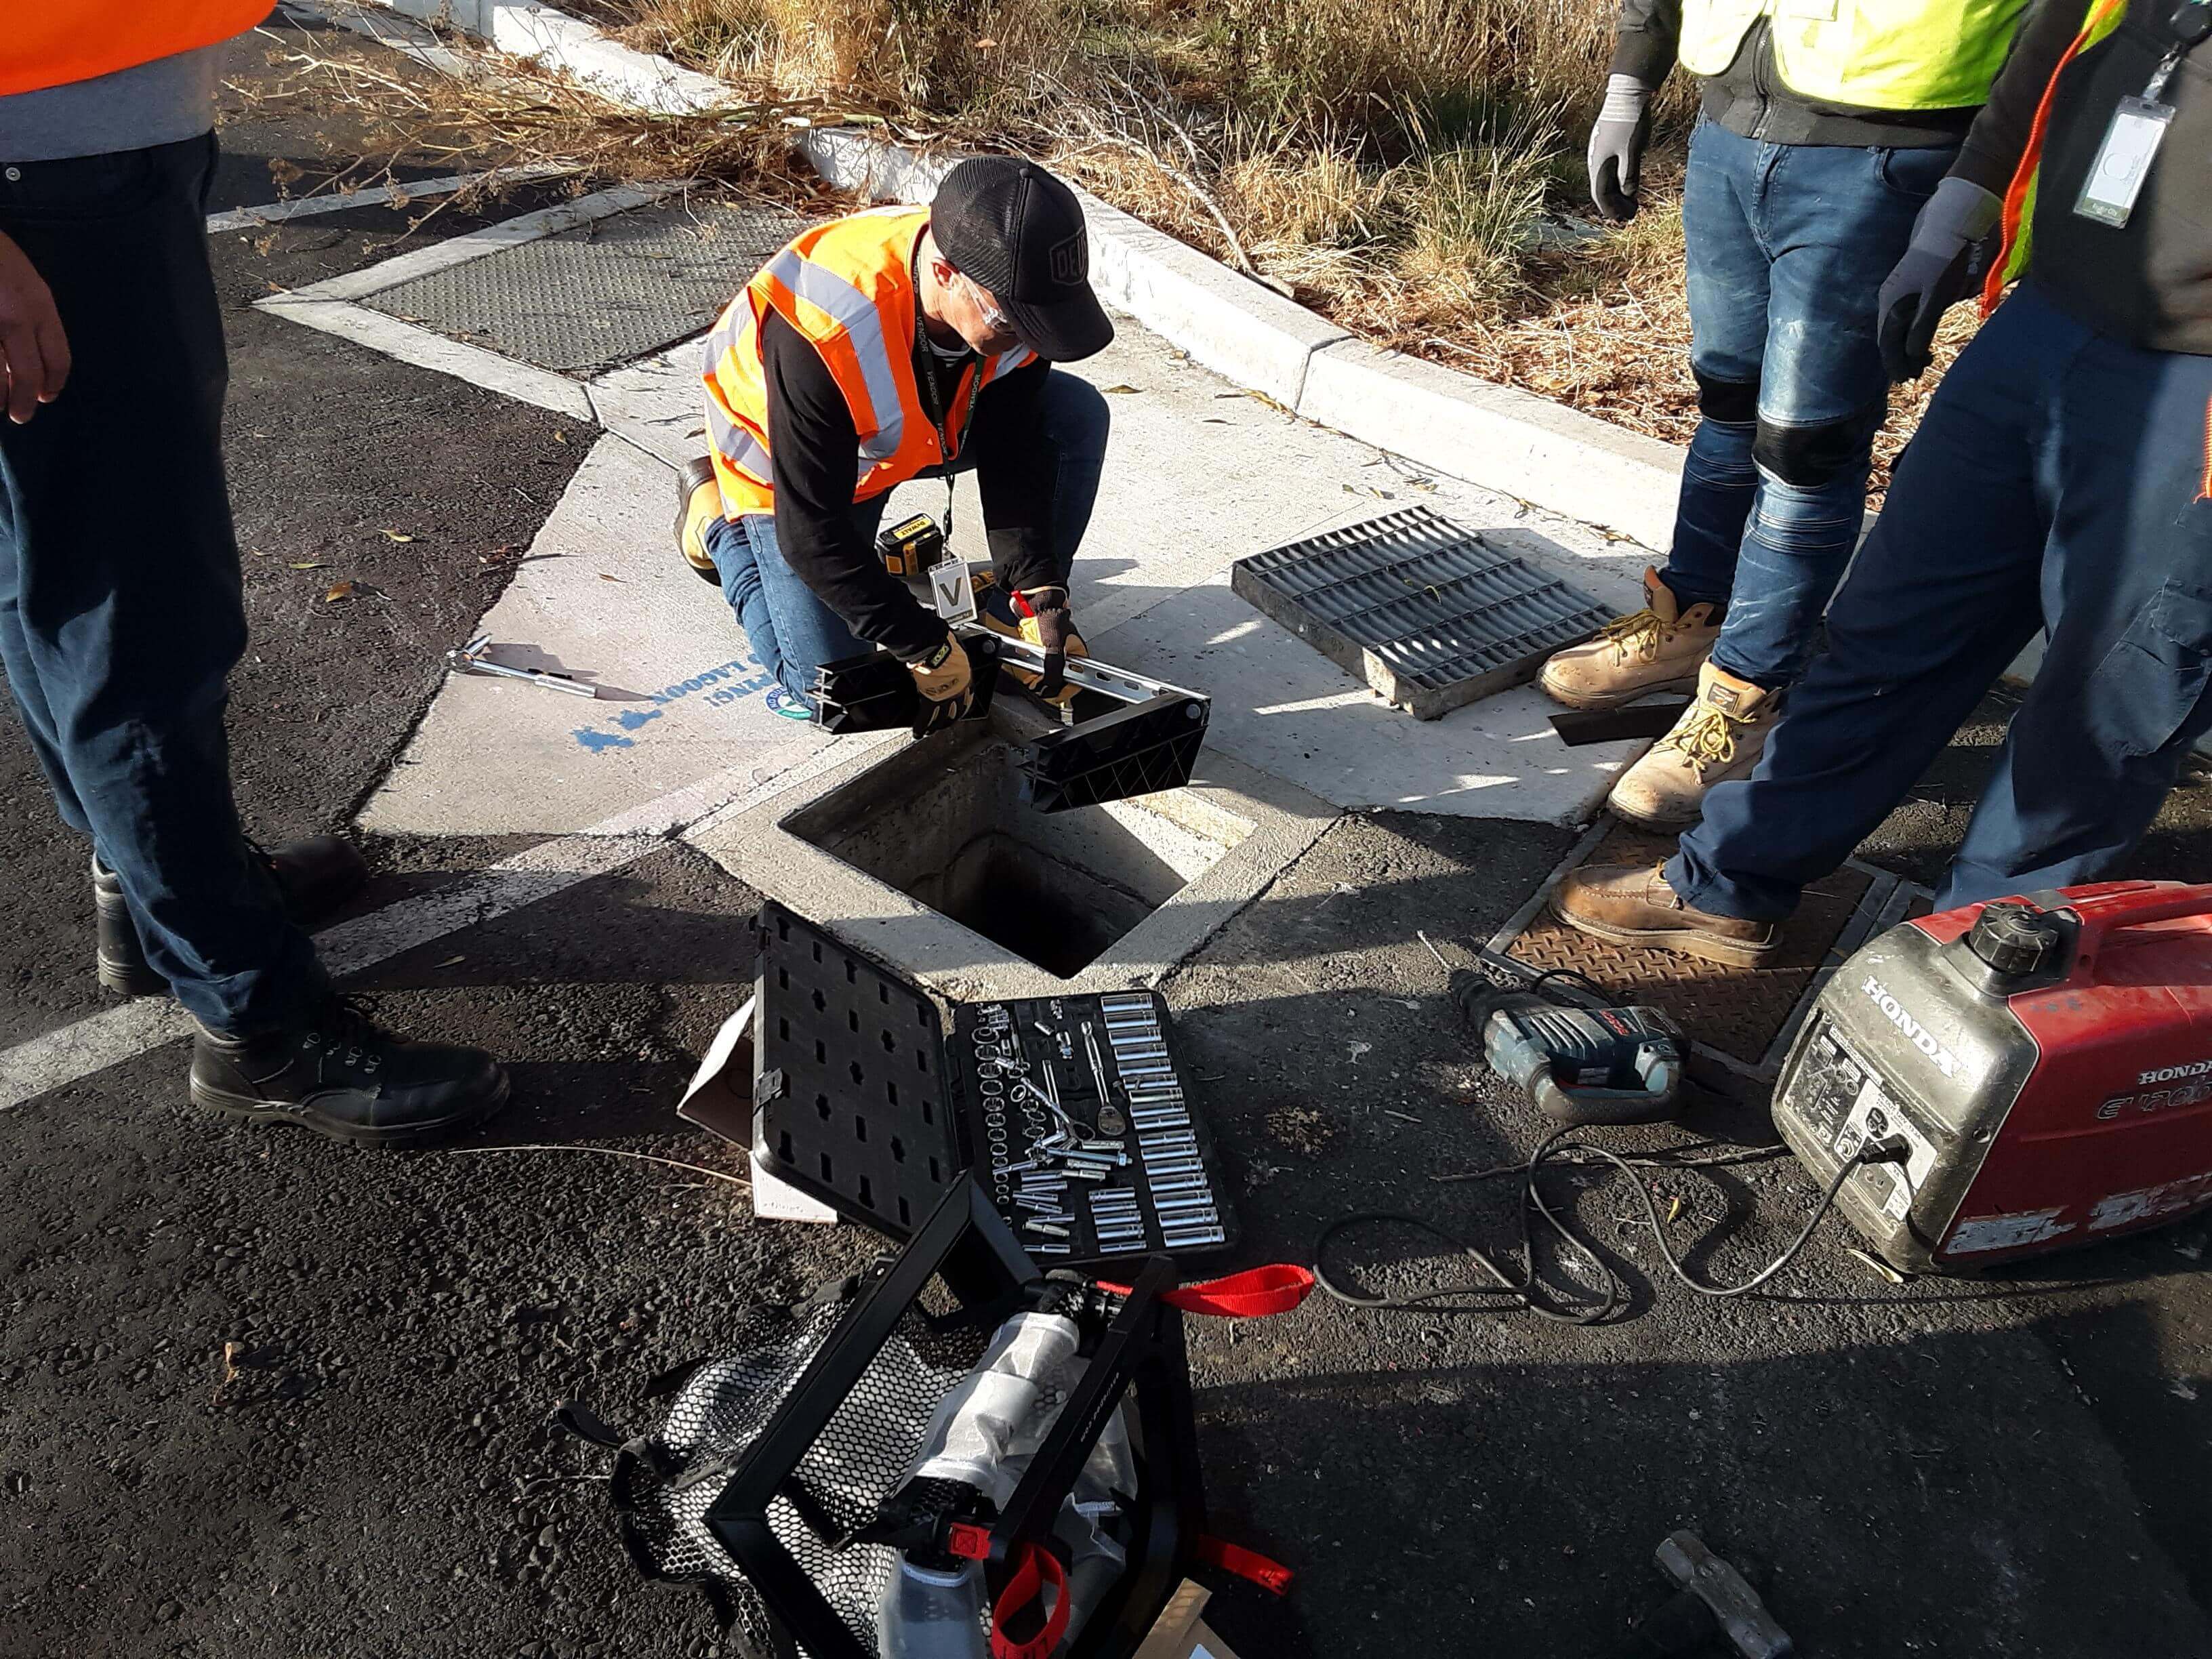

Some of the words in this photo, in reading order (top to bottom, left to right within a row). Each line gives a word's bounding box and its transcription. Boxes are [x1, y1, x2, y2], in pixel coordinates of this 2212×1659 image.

[916, 316, 929, 352] VENDOR
[927, 371, 939, 405] VENDOR
[968, 374, 981, 411] VENDOR
[939, 577, 962, 607] V
[651, 661, 748, 705] LAGOON
[1861, 975, 1959, 1078] HONDA
